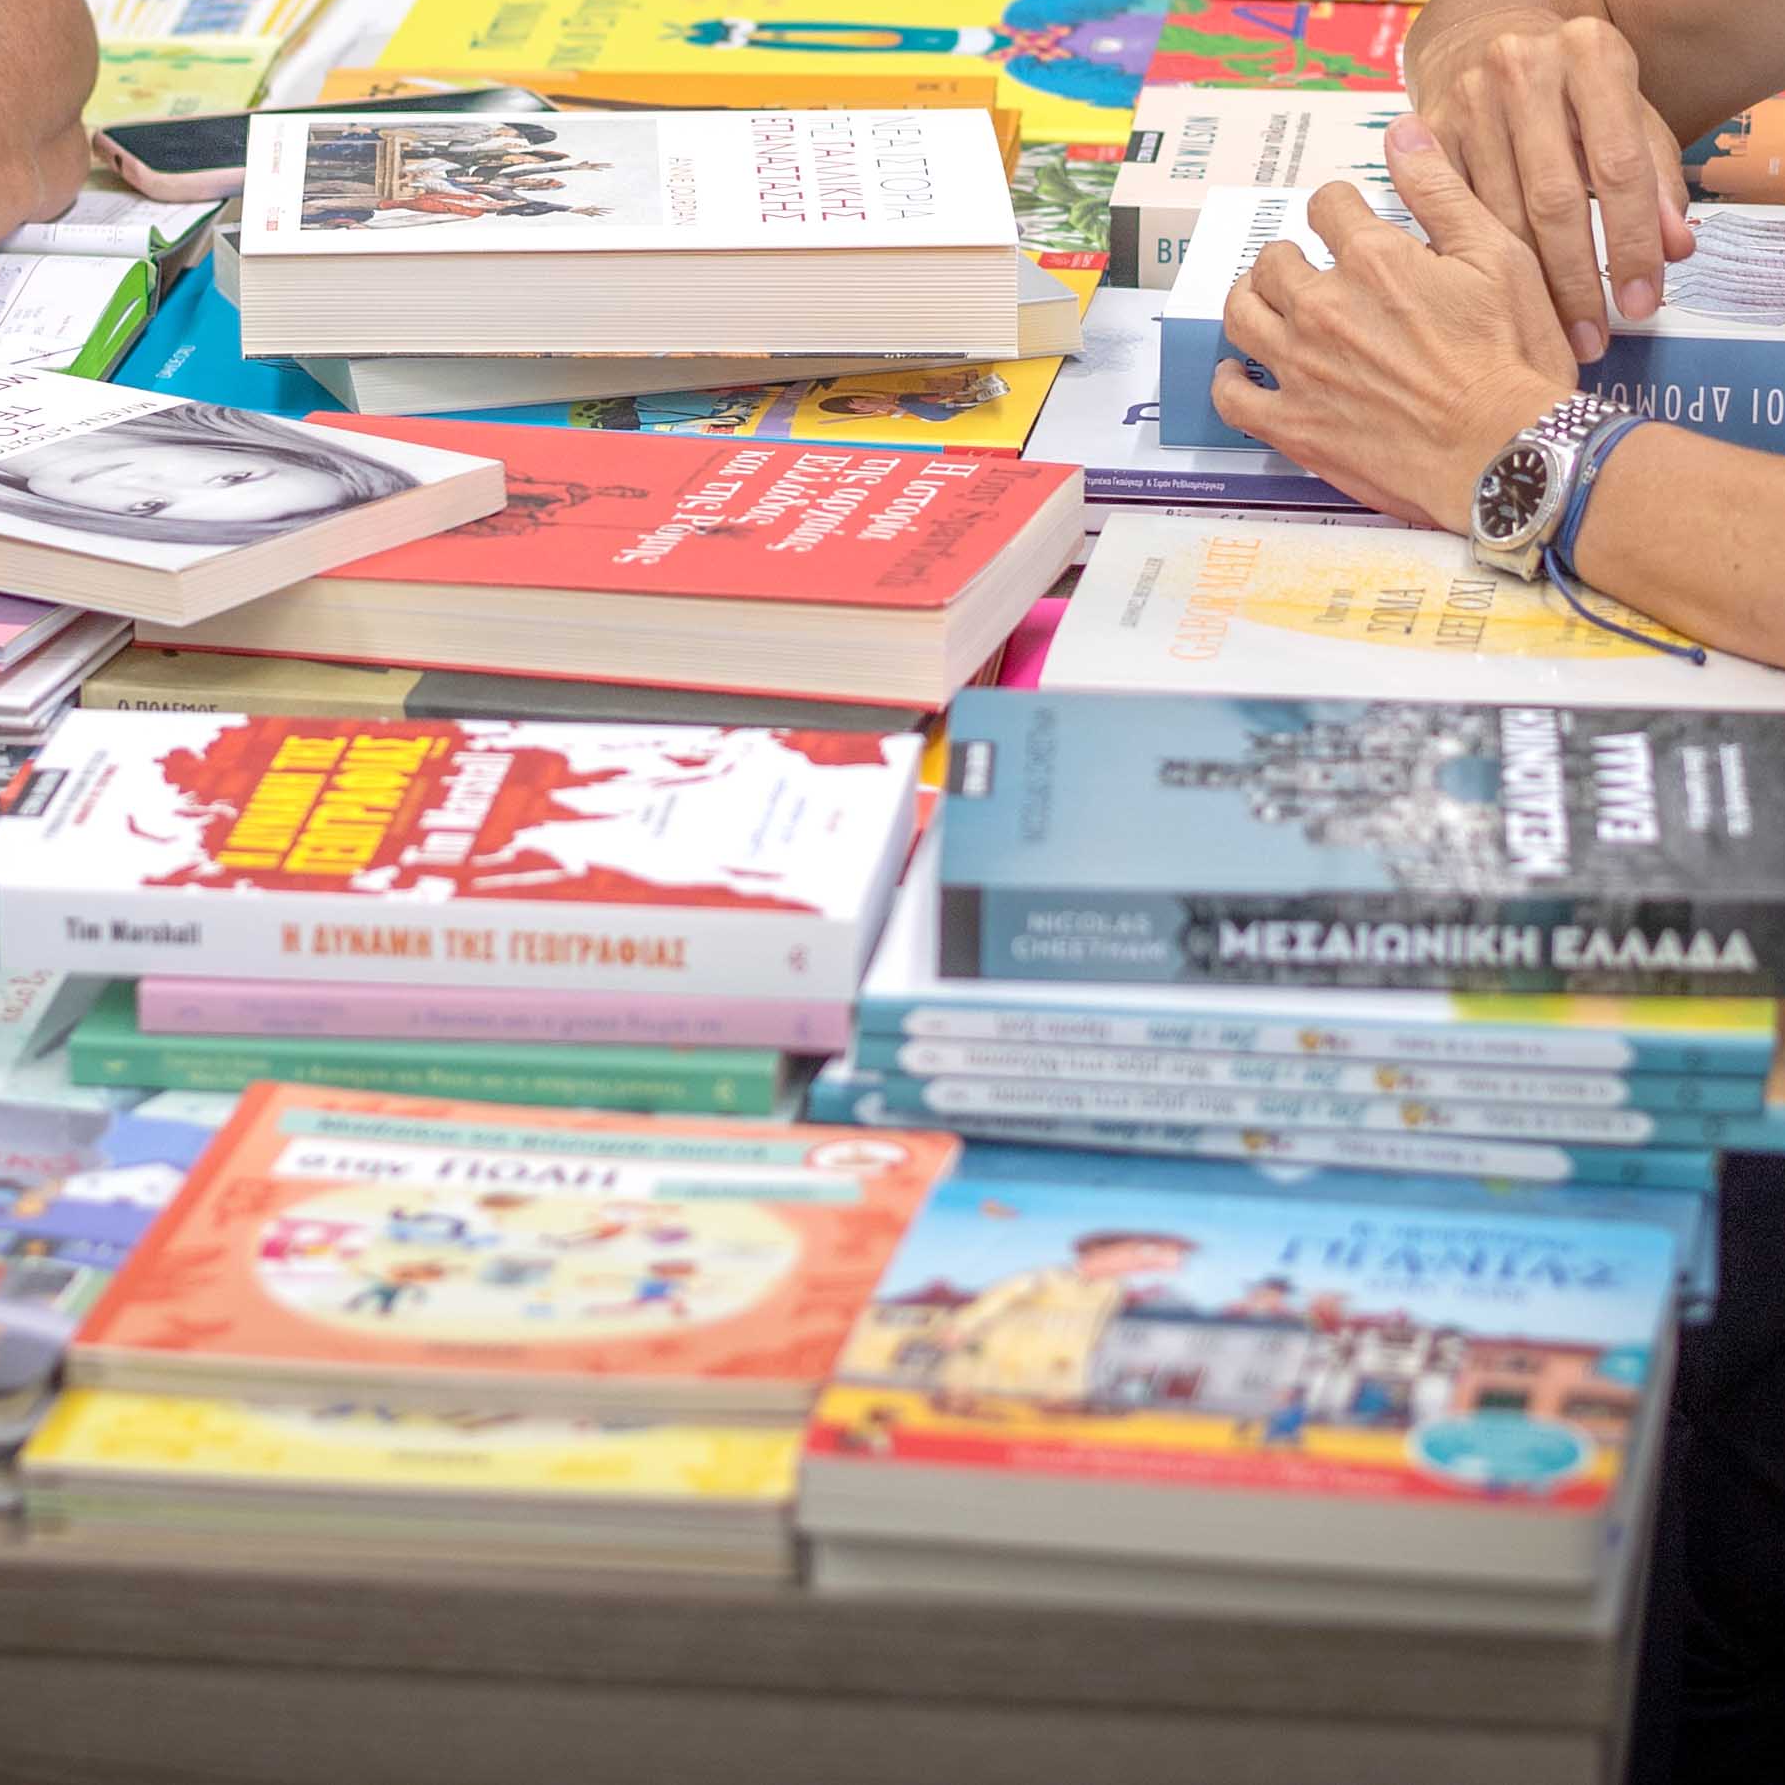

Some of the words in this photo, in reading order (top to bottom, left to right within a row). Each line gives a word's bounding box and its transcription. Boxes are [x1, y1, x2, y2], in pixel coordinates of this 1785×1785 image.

[808, 116, 853, 139] ΤΗΣ
[871, 116, 923, 150] ΝΕΑ
[1177, 116, 1220, 157] WILSON
[750, 118, 806, 223] ΕΠΑΝΑΣΤΑΣΗΣ
[811, 142, 867, 222] ΓΑΛΛΙΚΗΣ
[876, 153, 936, 222] ΙΣΤΟΡΙΑ
[1170, 161, 1208, 180] BEN
[79, 401, 159, 427] ΜΙΛΕΝΑ
[1751, 388, 1785, 426] ΟΙ
[718, 449, 777, 478] και
[834, 457, 901, 486] της
[919, 460, 980, 479] Η
[675, 480, 744, 511] της
[727, 452, 855, 526] Ελλάδας
[853, 479, 946, 542] ιστορία
[611, 512, 725, 566] Ρώμης
[763, 487, 871, 553] αρχαίας
[1367, 588, 1426, 635] ΣΩΜΑ
[1446, 577, 1497, 611] ΟΧΙ
[1168, 594, 1240, 663] GABOR
[282, 734, 437, 876] ΓΕΩΓΡΑΦΙΑΣ
[420, 751, 513, 829] Marshall
[1499, 706, 1567, 878] ΜΕΣΑΙΩΝΙΚΗ
[1591, 731, 1660, 844] ΕΛΛΑΔΑ
[64, 917, 105, 943] Tim
[113, 919, 204, 948] Marshall
[1025, 911, 1151, 935] NICOLAS
[281, 922, 302, 953] Η
[311, 924, 432, 959] ΔΥΝΑΜΗ
[443, 930, 499, 961] ΤΗΣ
[509, 931, 691, 969] ΓΕΩΓΡΑΦΙΑΣ
[1011, 936, 1166, 963] CHEETHAM
[1217, 918, 1541, 972] ΜΕΣΑΙΩΝΙΚΗ
[1548, 922, 1756, 979] ΕΛΛΑΔΑ
[435, 1156, 616, 1188] ΠΟΛΗ
